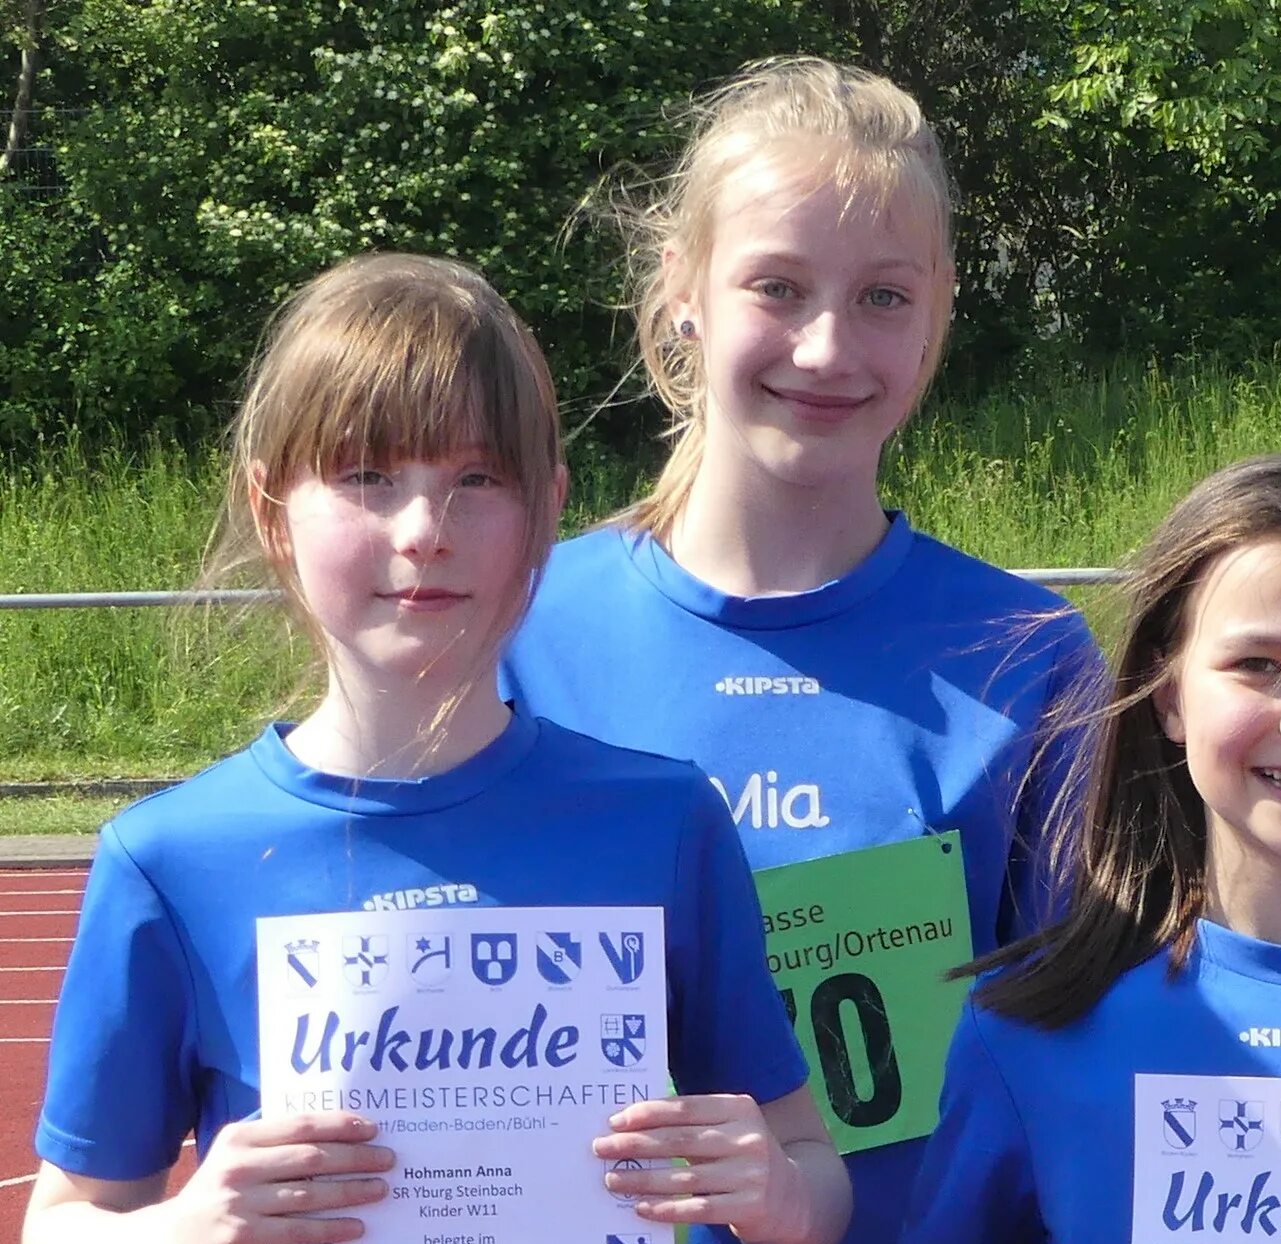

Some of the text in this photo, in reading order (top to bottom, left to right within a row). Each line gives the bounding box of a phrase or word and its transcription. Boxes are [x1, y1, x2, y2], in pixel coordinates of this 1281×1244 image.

[766, 917, 952, 974] burg/Ortenau
[290, 1003, 579, 1074] Urkunde
[777, 972, 902, 1127] 0
[285, 1083, 649, 1112] KREISMEISTERSCHAFTEN
[379, 1117, 545, 1134] tt/Baden-Baden/Bühl
[404, 1165, 512, 1179] Hohmann Anna
[393, 1183, 523, 1200] SR Yburg Steinbach
[419, 1204, 498, 1218] Kinder W11
